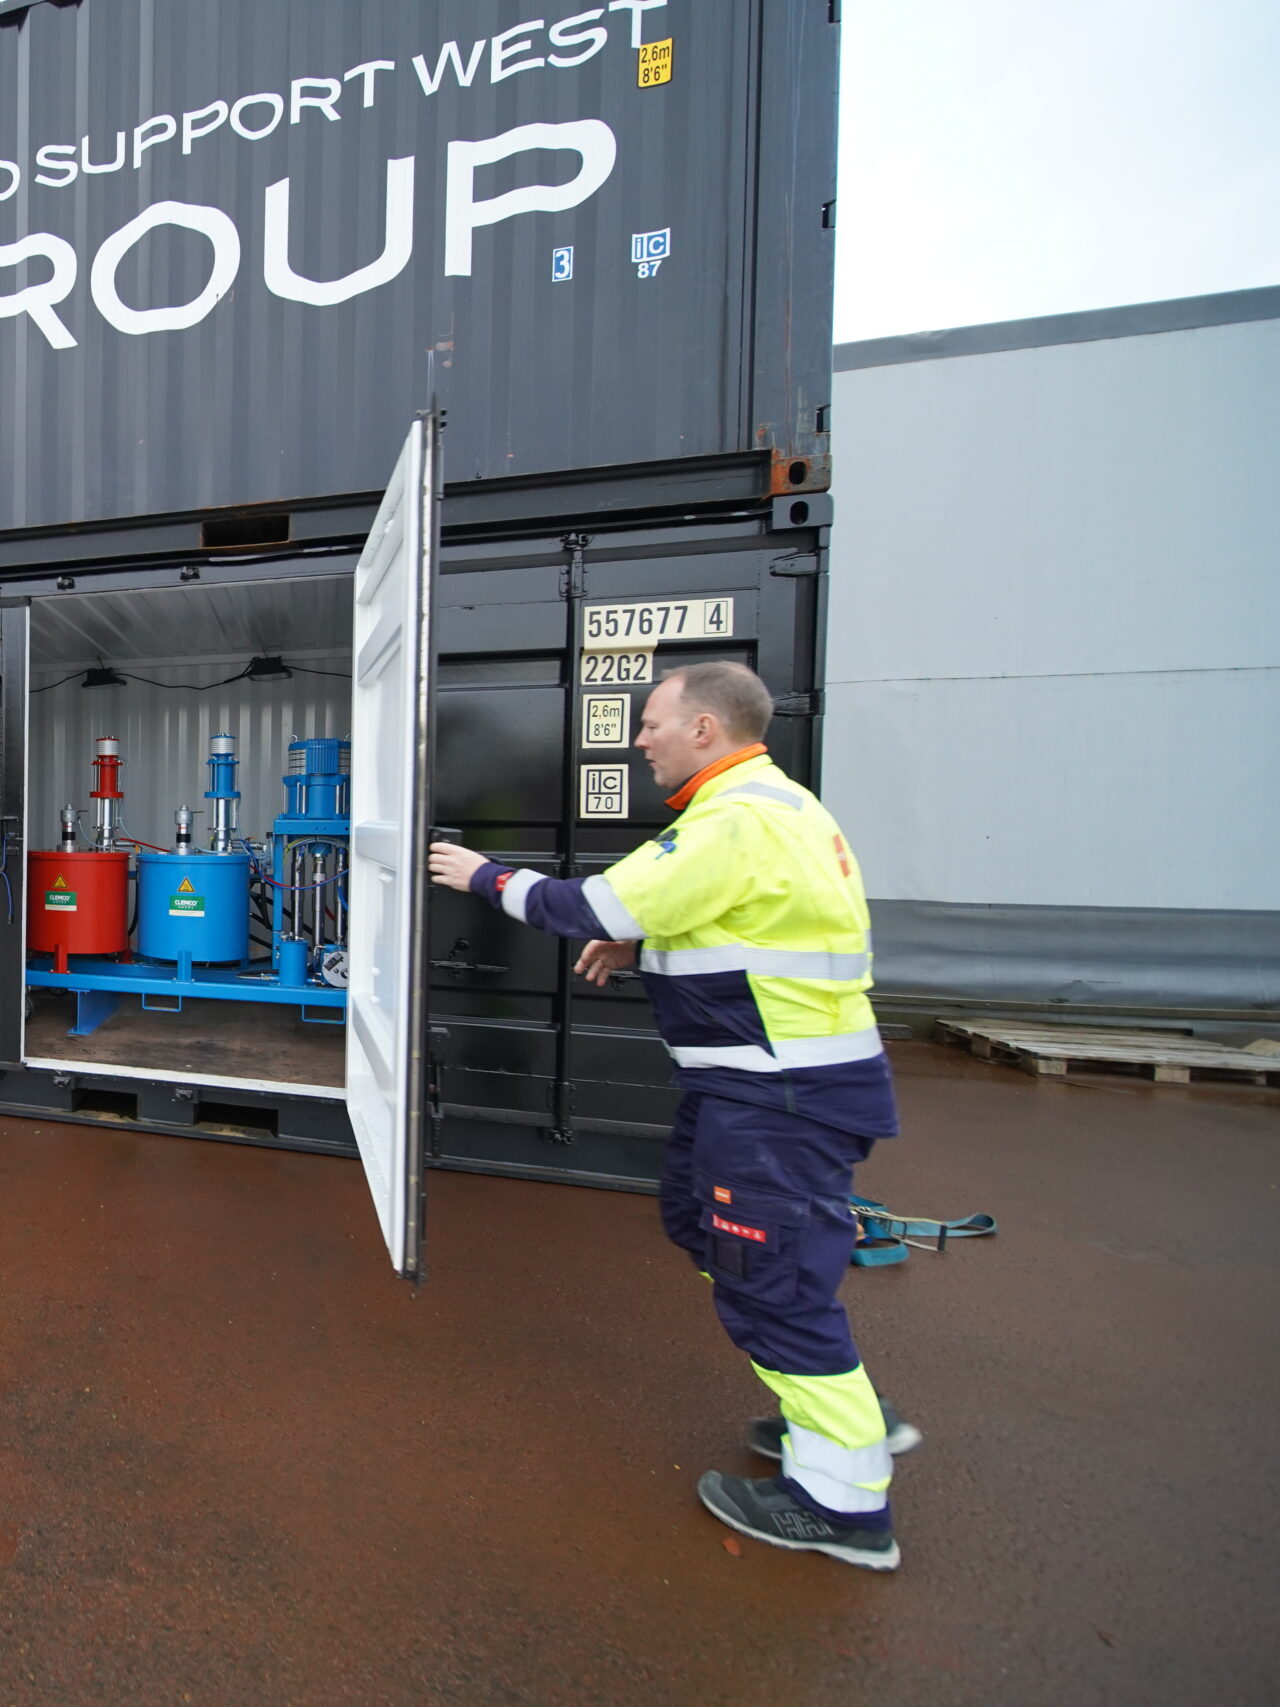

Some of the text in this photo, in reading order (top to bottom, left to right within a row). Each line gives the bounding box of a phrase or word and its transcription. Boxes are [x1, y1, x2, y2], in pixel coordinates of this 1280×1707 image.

[641, 45, 670, 65] 2,6m
[35, 61, 394, 187] SUPPORT
[413, 0, 668, 95] WEST
[555, 250, 570, 278] 3
[637, 260, 662, 279] 87
[588, 603, 724, 638] 557677 4
[584, 653, 648, 683] 22G2
[591, 704, 620, 720] 2,6m
[593, 723, 617, 737] 8'6"
